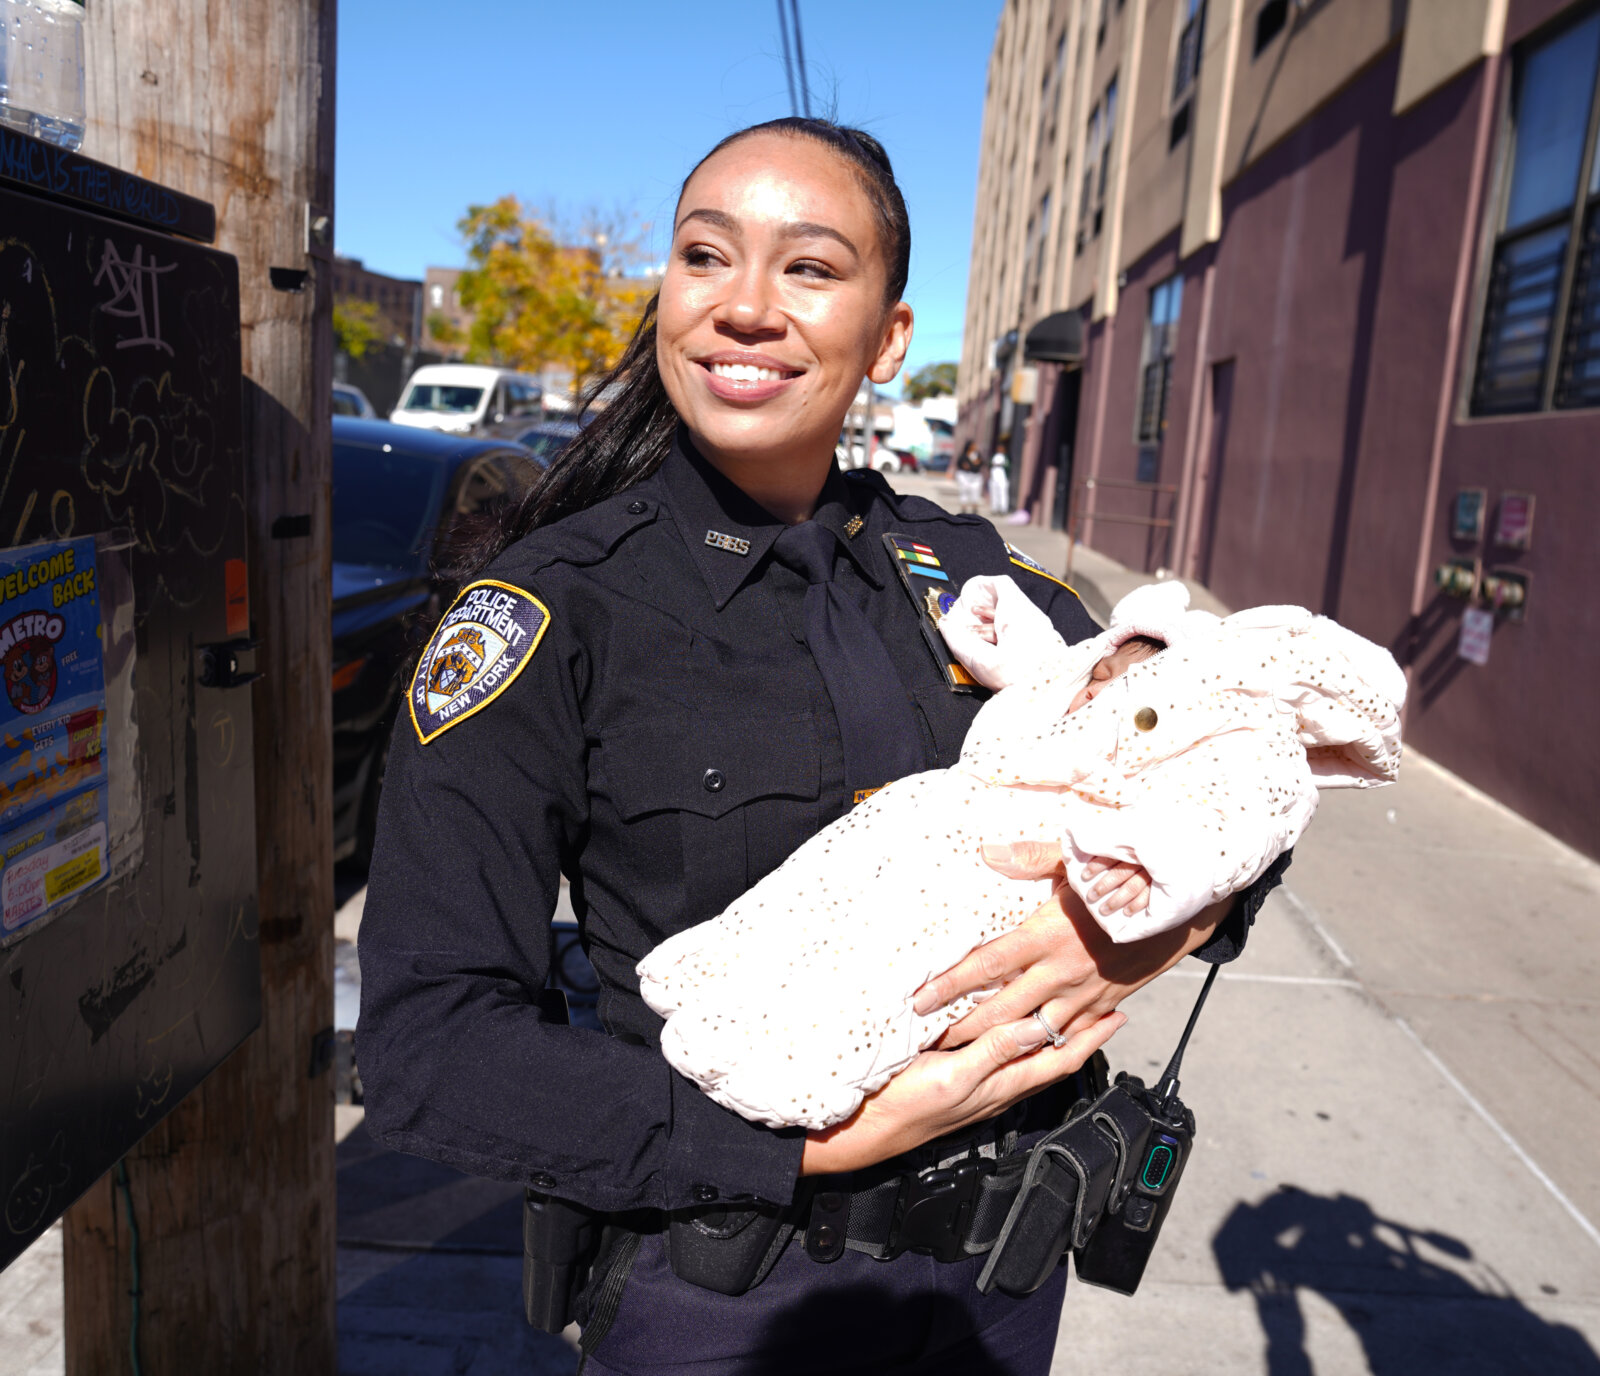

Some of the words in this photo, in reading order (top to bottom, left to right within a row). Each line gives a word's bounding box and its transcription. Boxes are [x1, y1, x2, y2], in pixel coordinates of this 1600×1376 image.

[52, 567, 95, 608] BACK
[465, 589, 518, 616] POLICE
[0, 614, 63, 659] METRO
[441, 605, 527, 647] DEPARTMENT
[417, 645, 436, 680] CITY
[473, 653, 516, 693] YORK
[416, 687, 427, 706] OF
[439, 692, 471, 721] NEW
[32, 718, 57, 737] EVERY
[72, 726, 94, 743] CHIPS
[34, 735, 54, 752] GETS
[86, 737, 102, 759] X2
